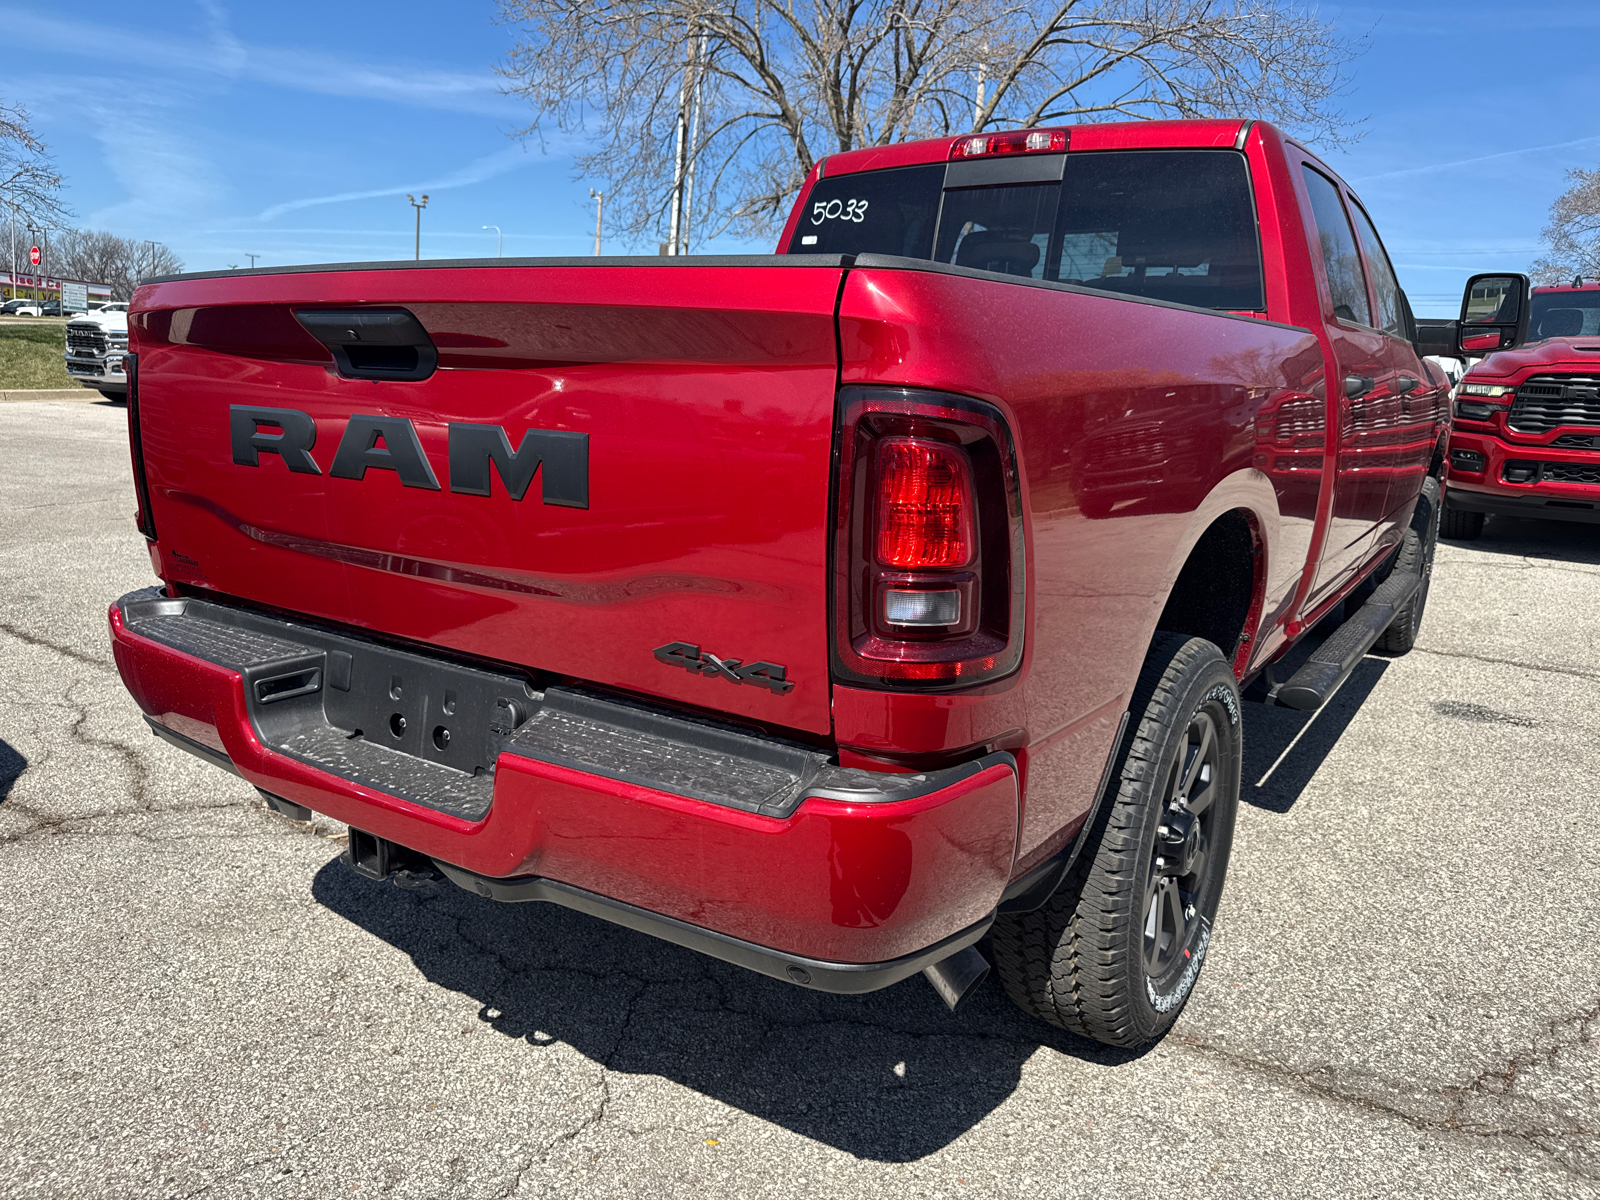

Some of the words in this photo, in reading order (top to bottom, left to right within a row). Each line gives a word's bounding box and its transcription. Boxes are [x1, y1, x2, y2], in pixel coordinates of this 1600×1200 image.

[811, 198, 869, 226] 5033
[9, 274, 42, 286] Used
[229, 403, 589, 510] RAM
